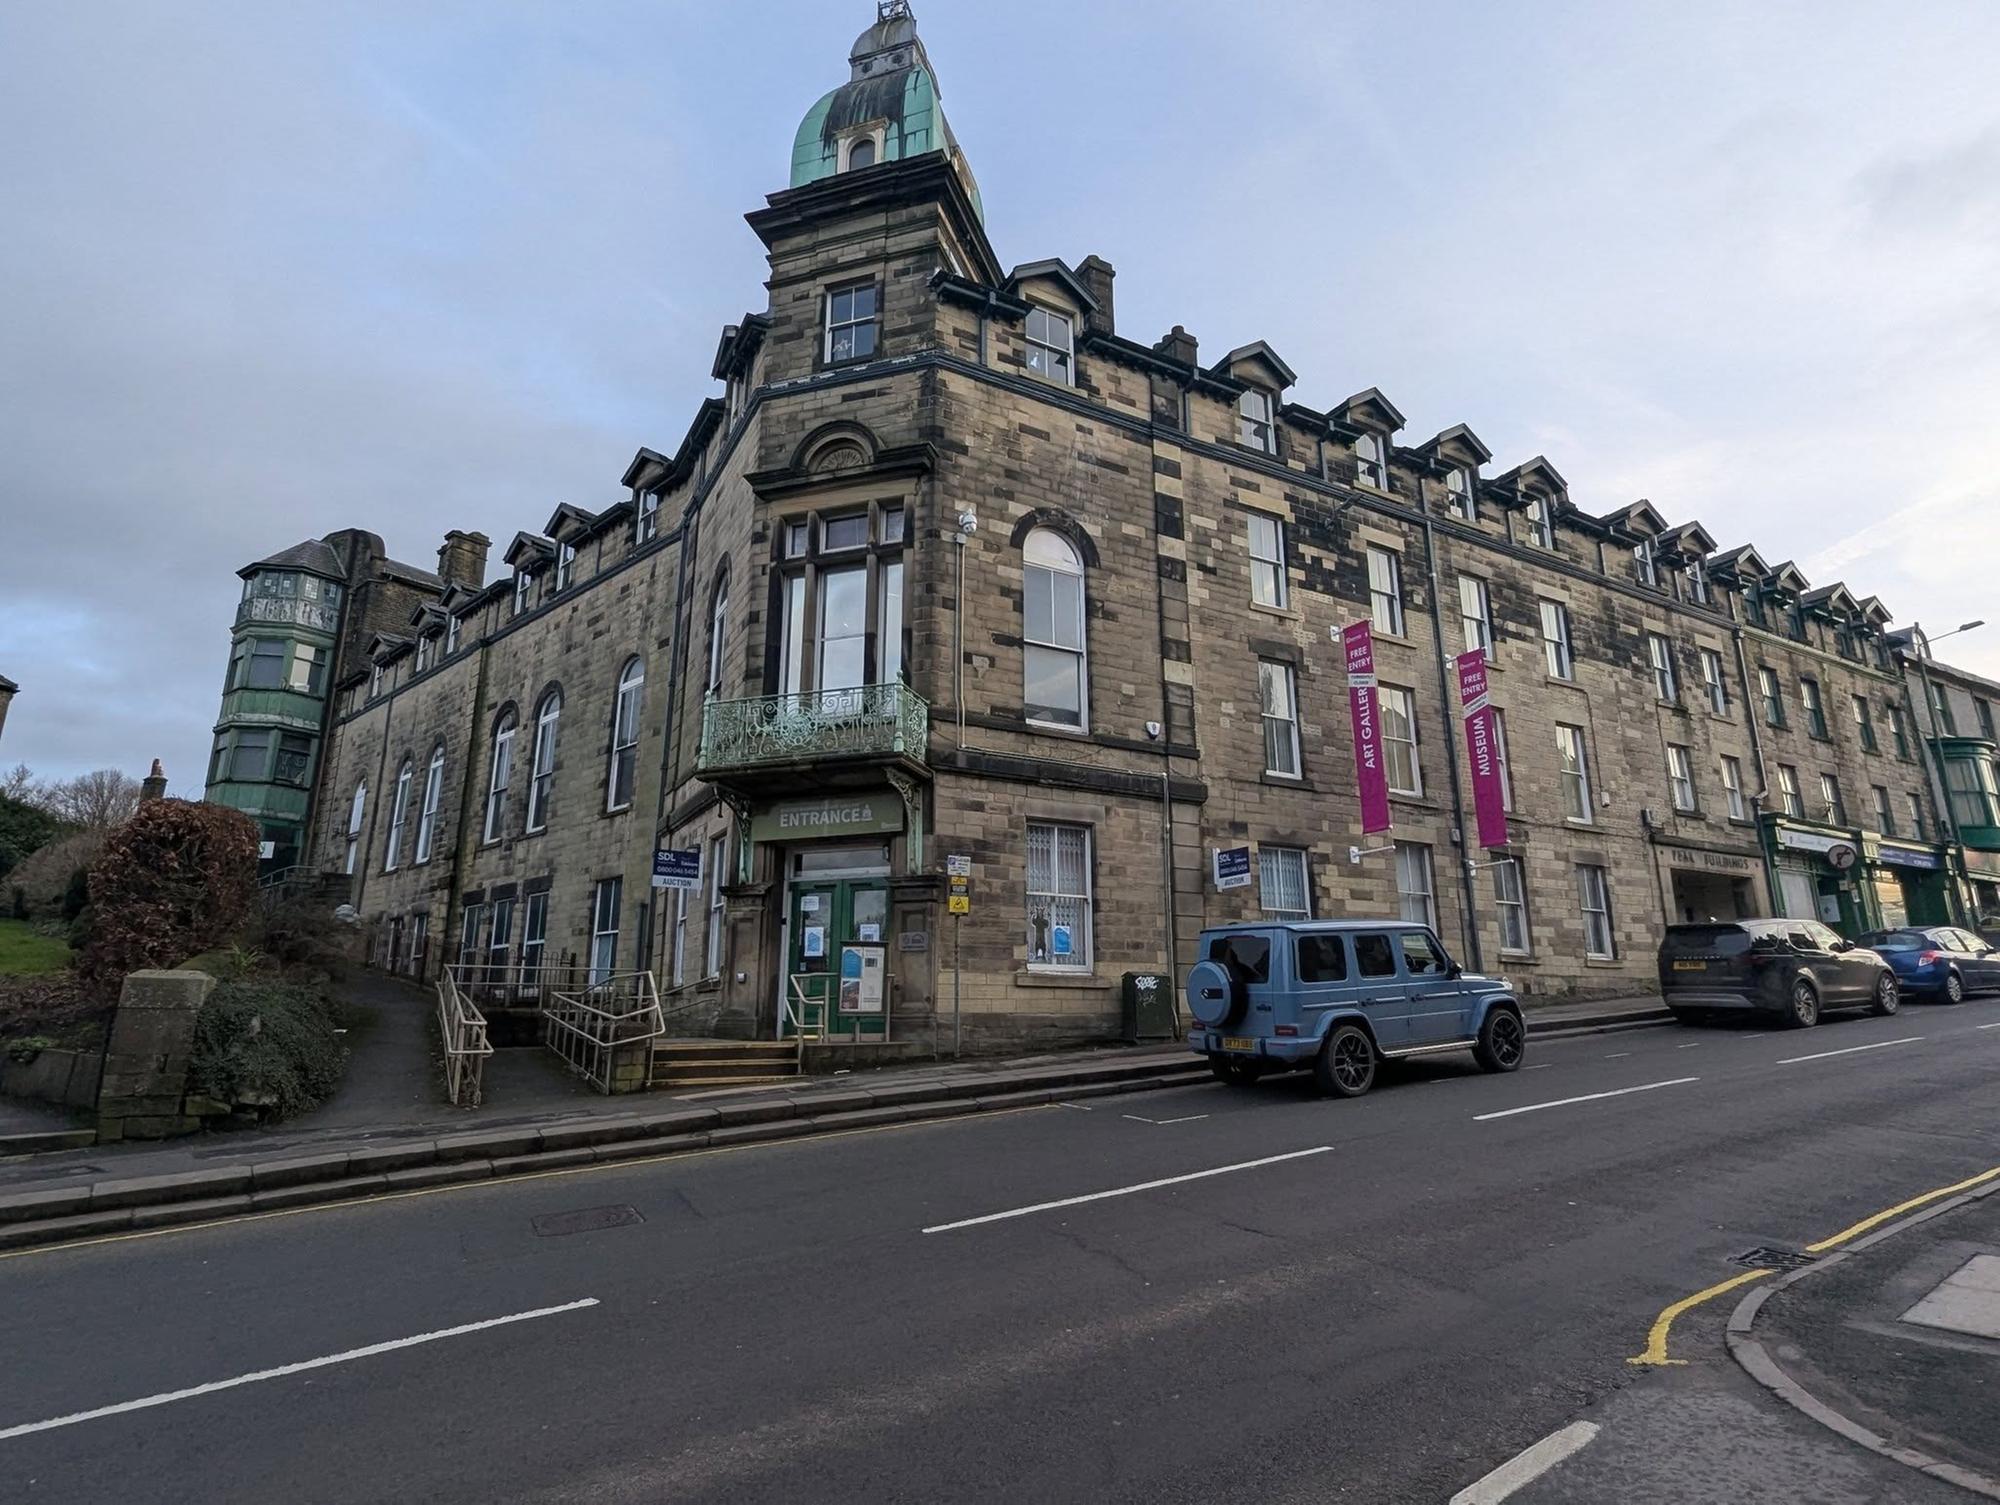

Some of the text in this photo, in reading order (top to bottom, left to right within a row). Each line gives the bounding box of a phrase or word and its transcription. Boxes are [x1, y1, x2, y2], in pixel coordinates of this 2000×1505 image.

[1350, 645, 1368, 659] FREE
[1348, 655, 1371, 671] ENTRY
[1464, 672, 1482, 685] FREE
[1462, 681, 1486, 696] ENTRY
[1357, 687, 1375, 769] ART GALLER
[1473, 716, 1491, 776] MUSEUM
[780, 808, 860, 827] ENTRANCE
[657, 851, 676, 861] SDL
[662, 877, 692, 887] AUCTION
